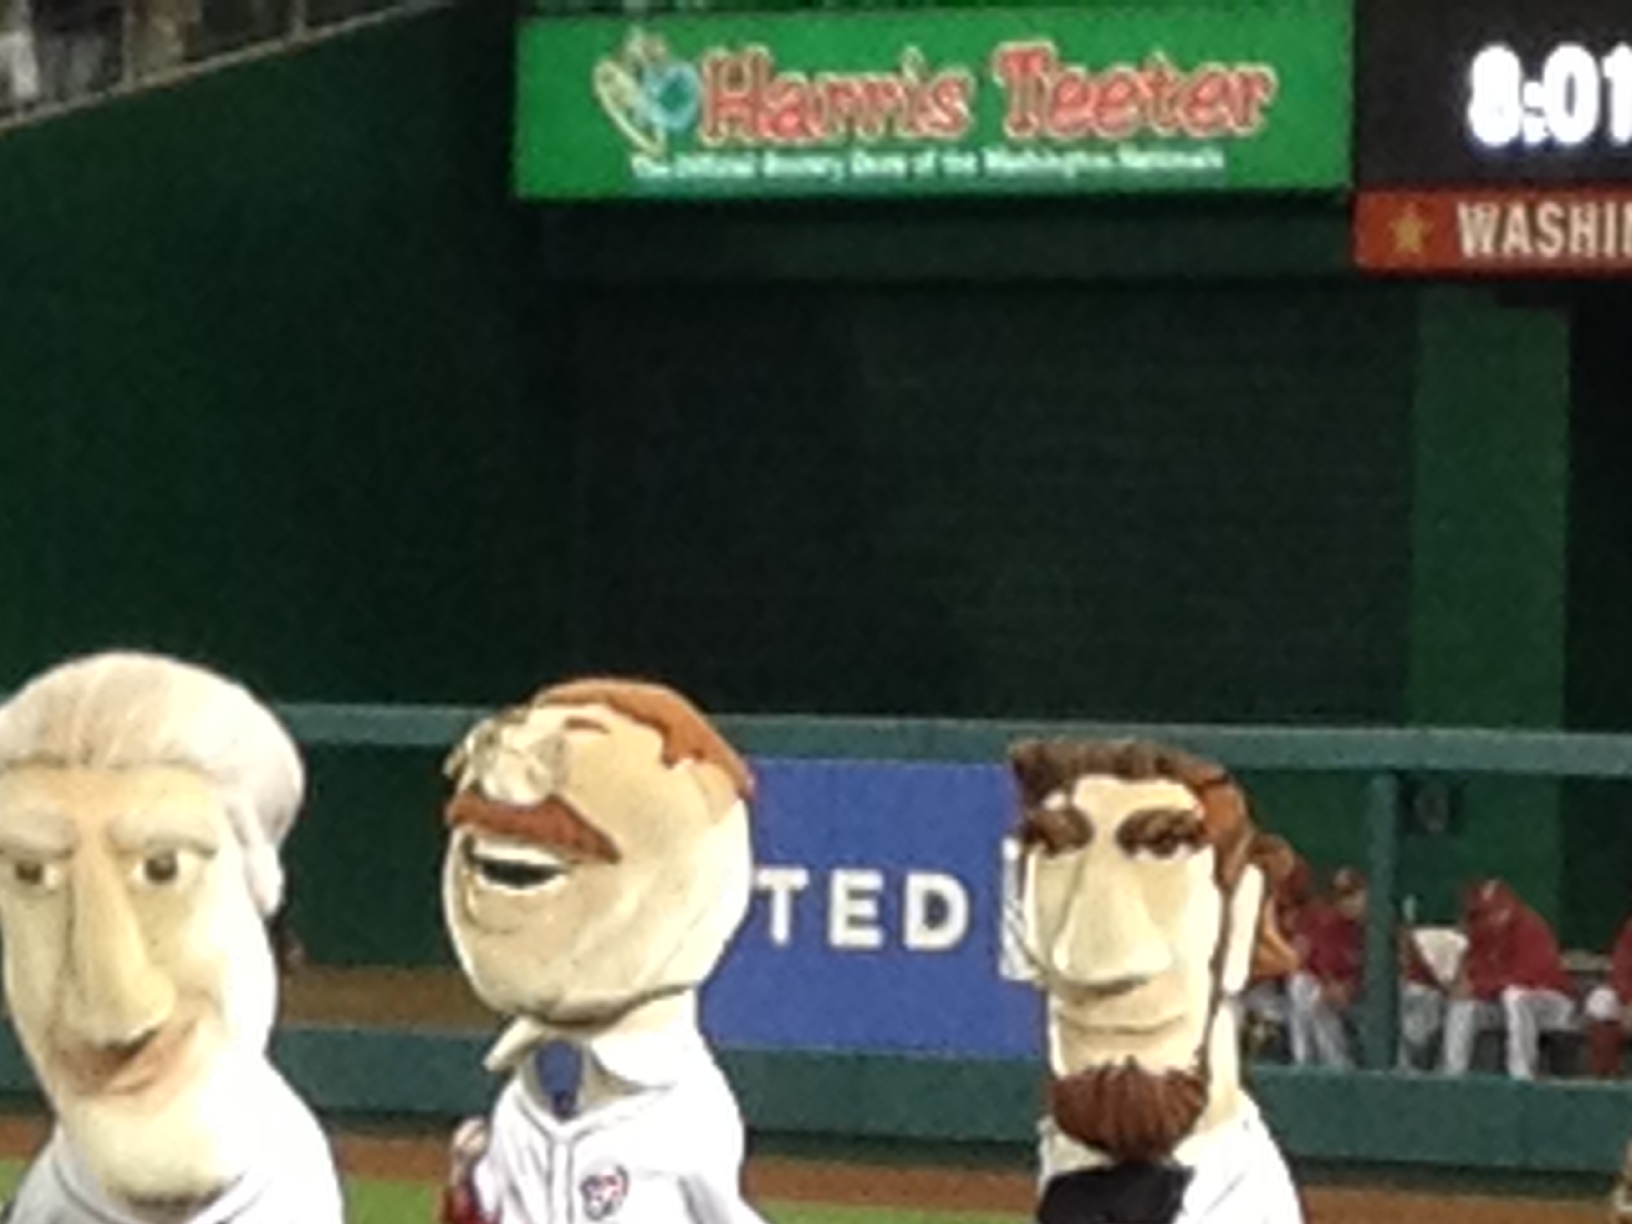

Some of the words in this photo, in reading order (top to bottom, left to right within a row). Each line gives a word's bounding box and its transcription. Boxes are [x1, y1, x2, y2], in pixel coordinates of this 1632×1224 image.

[700, 45, 974, 147] Harris
[993, 39, 1279, 138] Teeter
[1468, 42, 1632, 148] 8:01
[756, 867, 969, 950] TED
